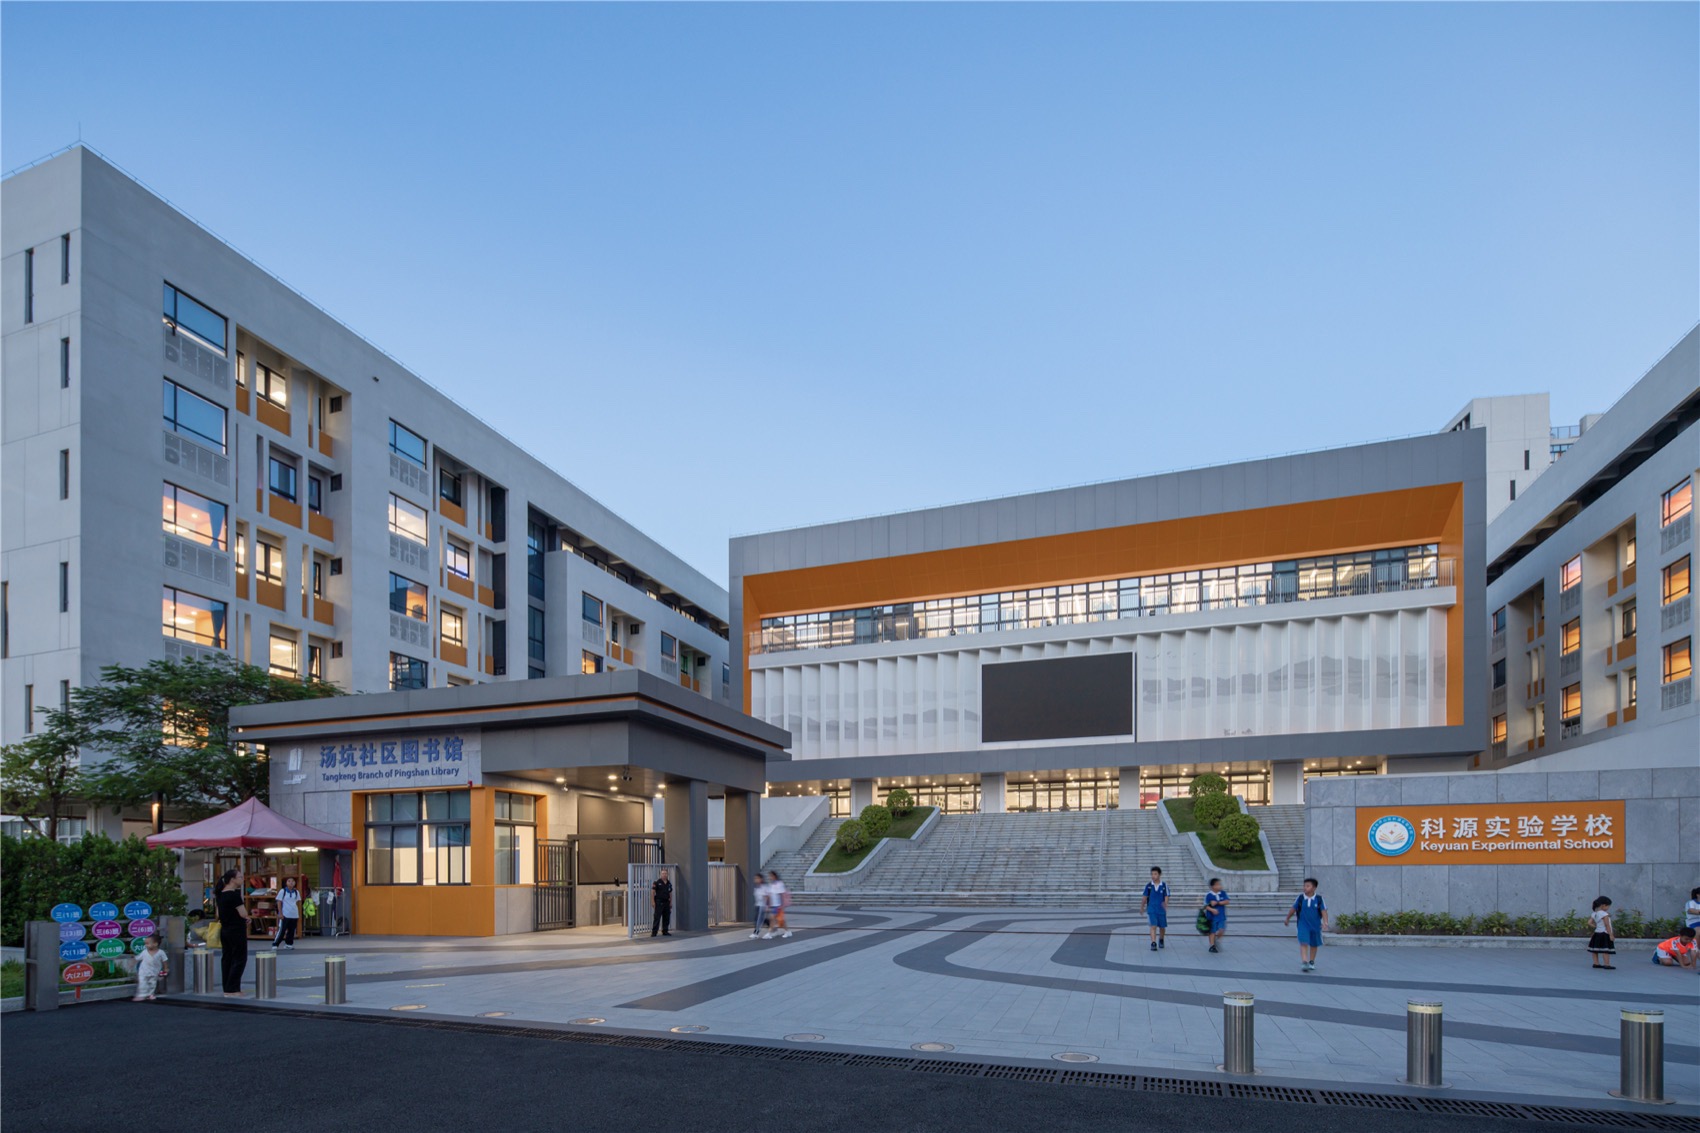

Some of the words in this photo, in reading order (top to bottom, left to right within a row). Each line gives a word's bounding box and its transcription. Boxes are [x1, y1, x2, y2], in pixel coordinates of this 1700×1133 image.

[319, 736, 464, 768] 汤坑社区图书馆
[322, 772, 356, 783] Tangkeng
[358, 769, 383, 780] Branch
[385, 769, 393, 778] of
[395, 767, 429, 779] Pingshan
[431, 766, 460, 777] Library
[1420, 814, 1613, 840] 科源实验学校
[1421, 840, 1469, 853] Keyuan
[1471, 839, 1561, 852] Experimental
[1563, 838, 1613, 849] School
